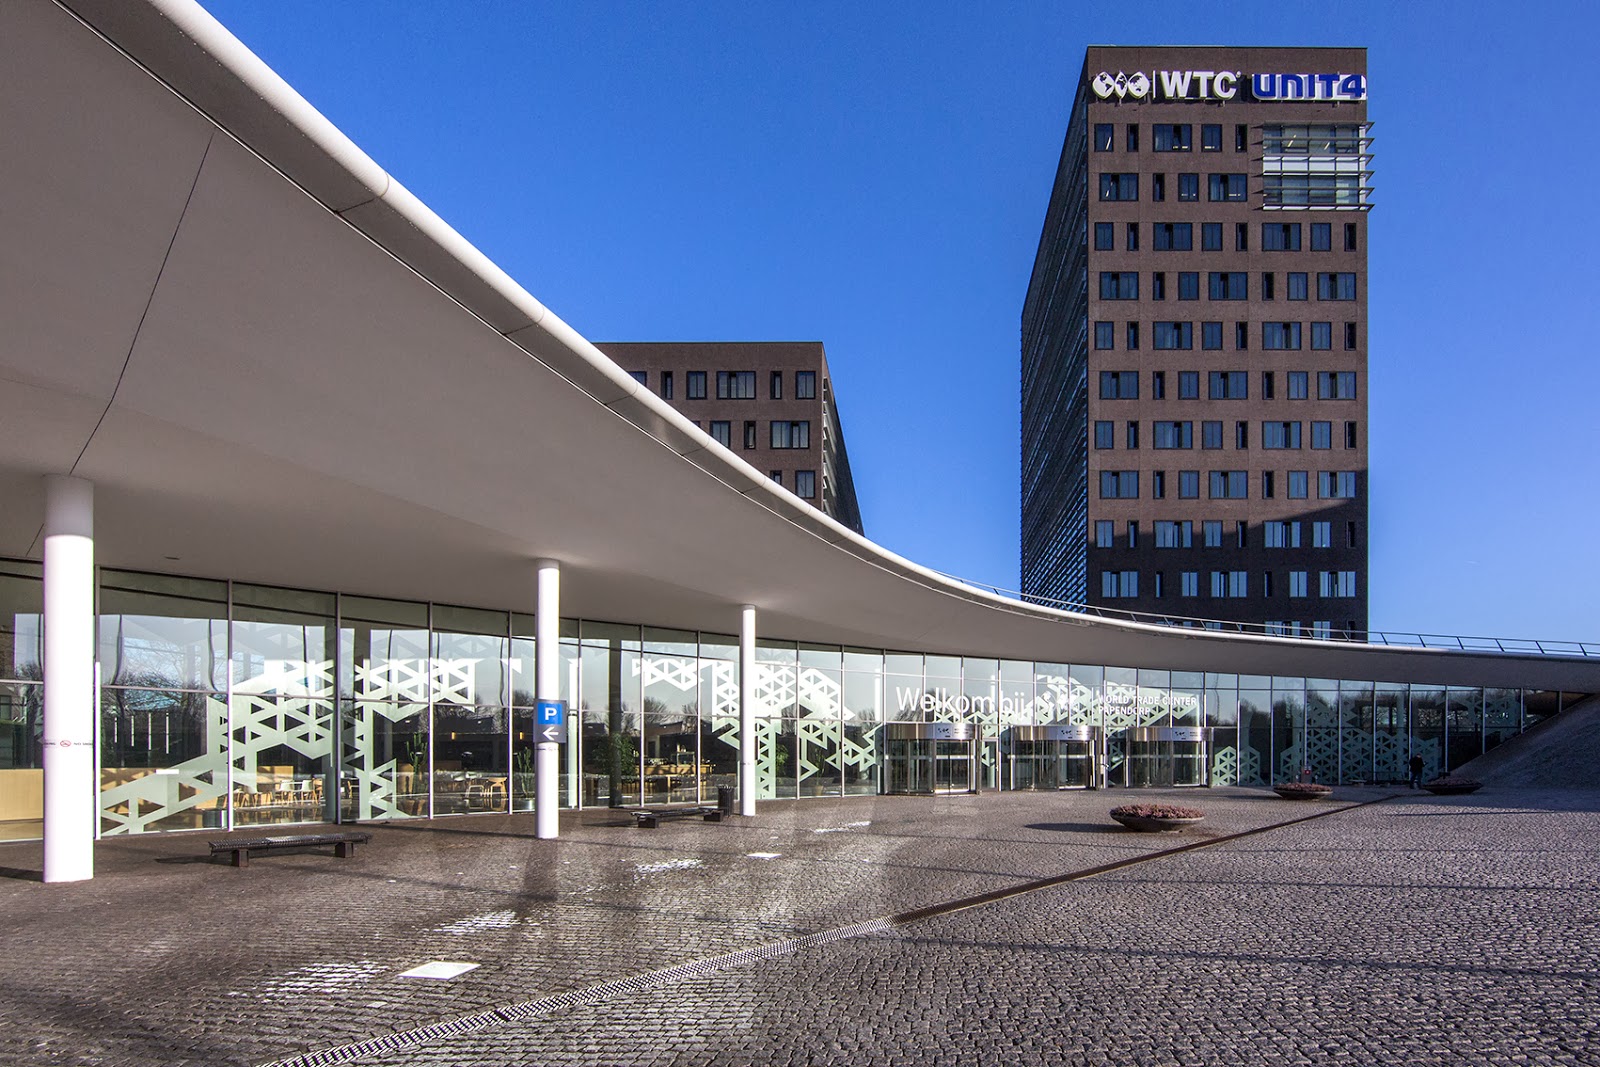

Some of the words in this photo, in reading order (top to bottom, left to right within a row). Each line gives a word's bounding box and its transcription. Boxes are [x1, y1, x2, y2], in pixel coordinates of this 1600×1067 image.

[1160, 70, 1238, 100] WTC
[1251, 73, 1367, 101] UNIT4
[544, 707, 557, 721] P
[896, 686, 996, 714] Welkom
[999, 690, 1025, 719] bij
[1098, 695, 1129, 704] WORLD
[1132, 696, 1159, 705] TRADE
[1162, 697, 1197, 706] CENTER
